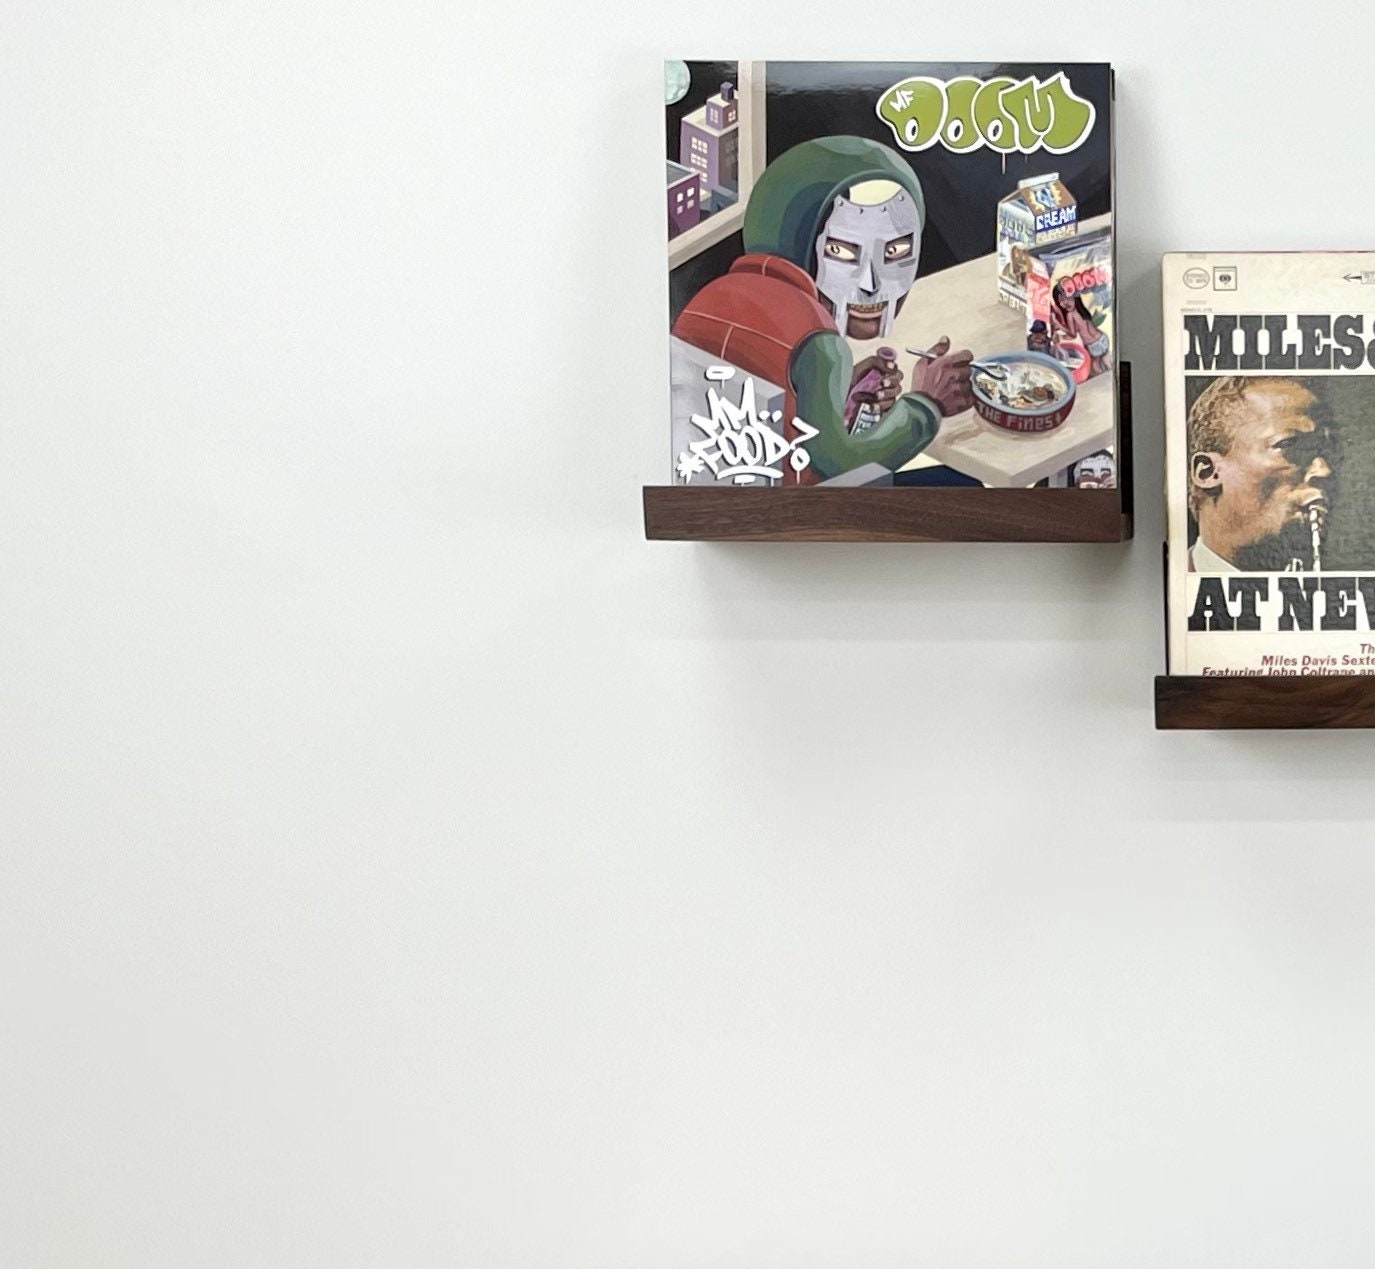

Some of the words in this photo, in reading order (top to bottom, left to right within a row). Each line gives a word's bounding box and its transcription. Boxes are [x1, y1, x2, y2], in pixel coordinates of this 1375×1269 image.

[977, 401, 1000, 423] THE
[1187, 577, 1269, 631] AT
[1261, 655, 1298, 667] Miles
[1302, 655, 1337, 667] Davis
[1268, 666, 1297, 677] John
[1301, 666, 1355, 676] Coltrane
